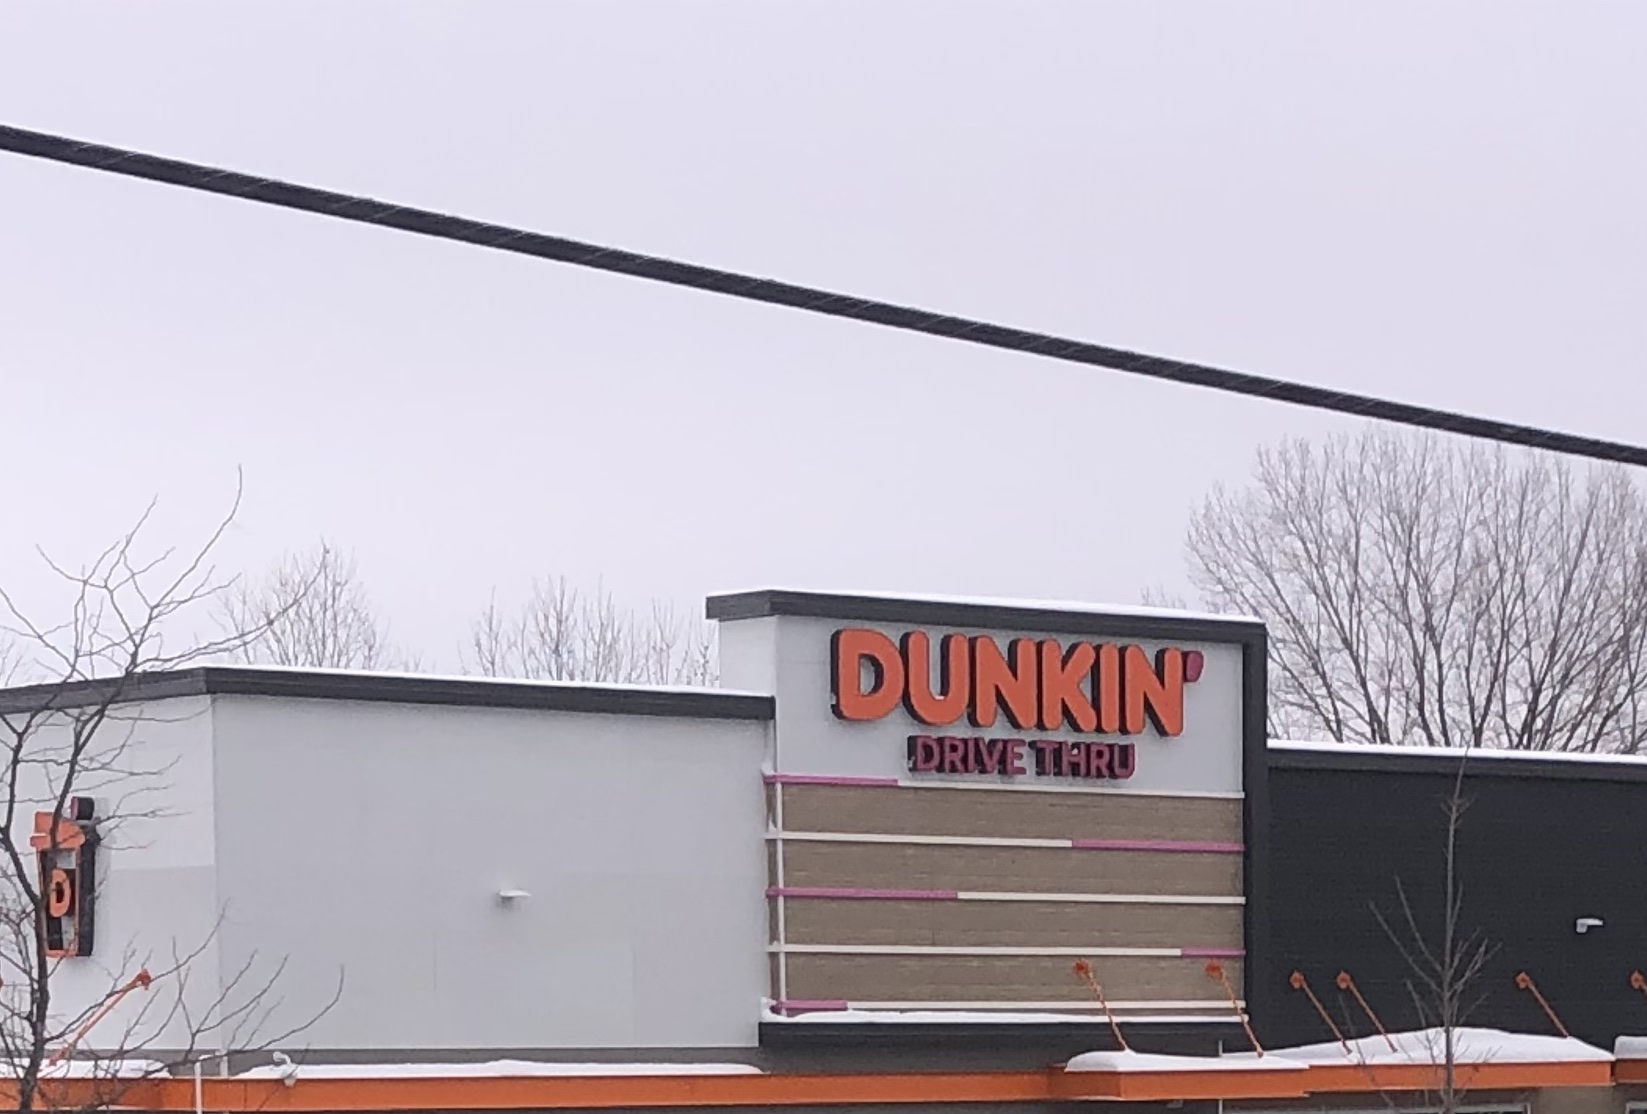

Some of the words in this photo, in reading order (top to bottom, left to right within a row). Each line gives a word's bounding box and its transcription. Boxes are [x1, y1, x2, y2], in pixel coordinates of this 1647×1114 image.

[832, 628, 1203, 737] DUNKIN'
[908, 735, 1027, 776] DRIVE
[1030, 738, 1135, 779] THRU
